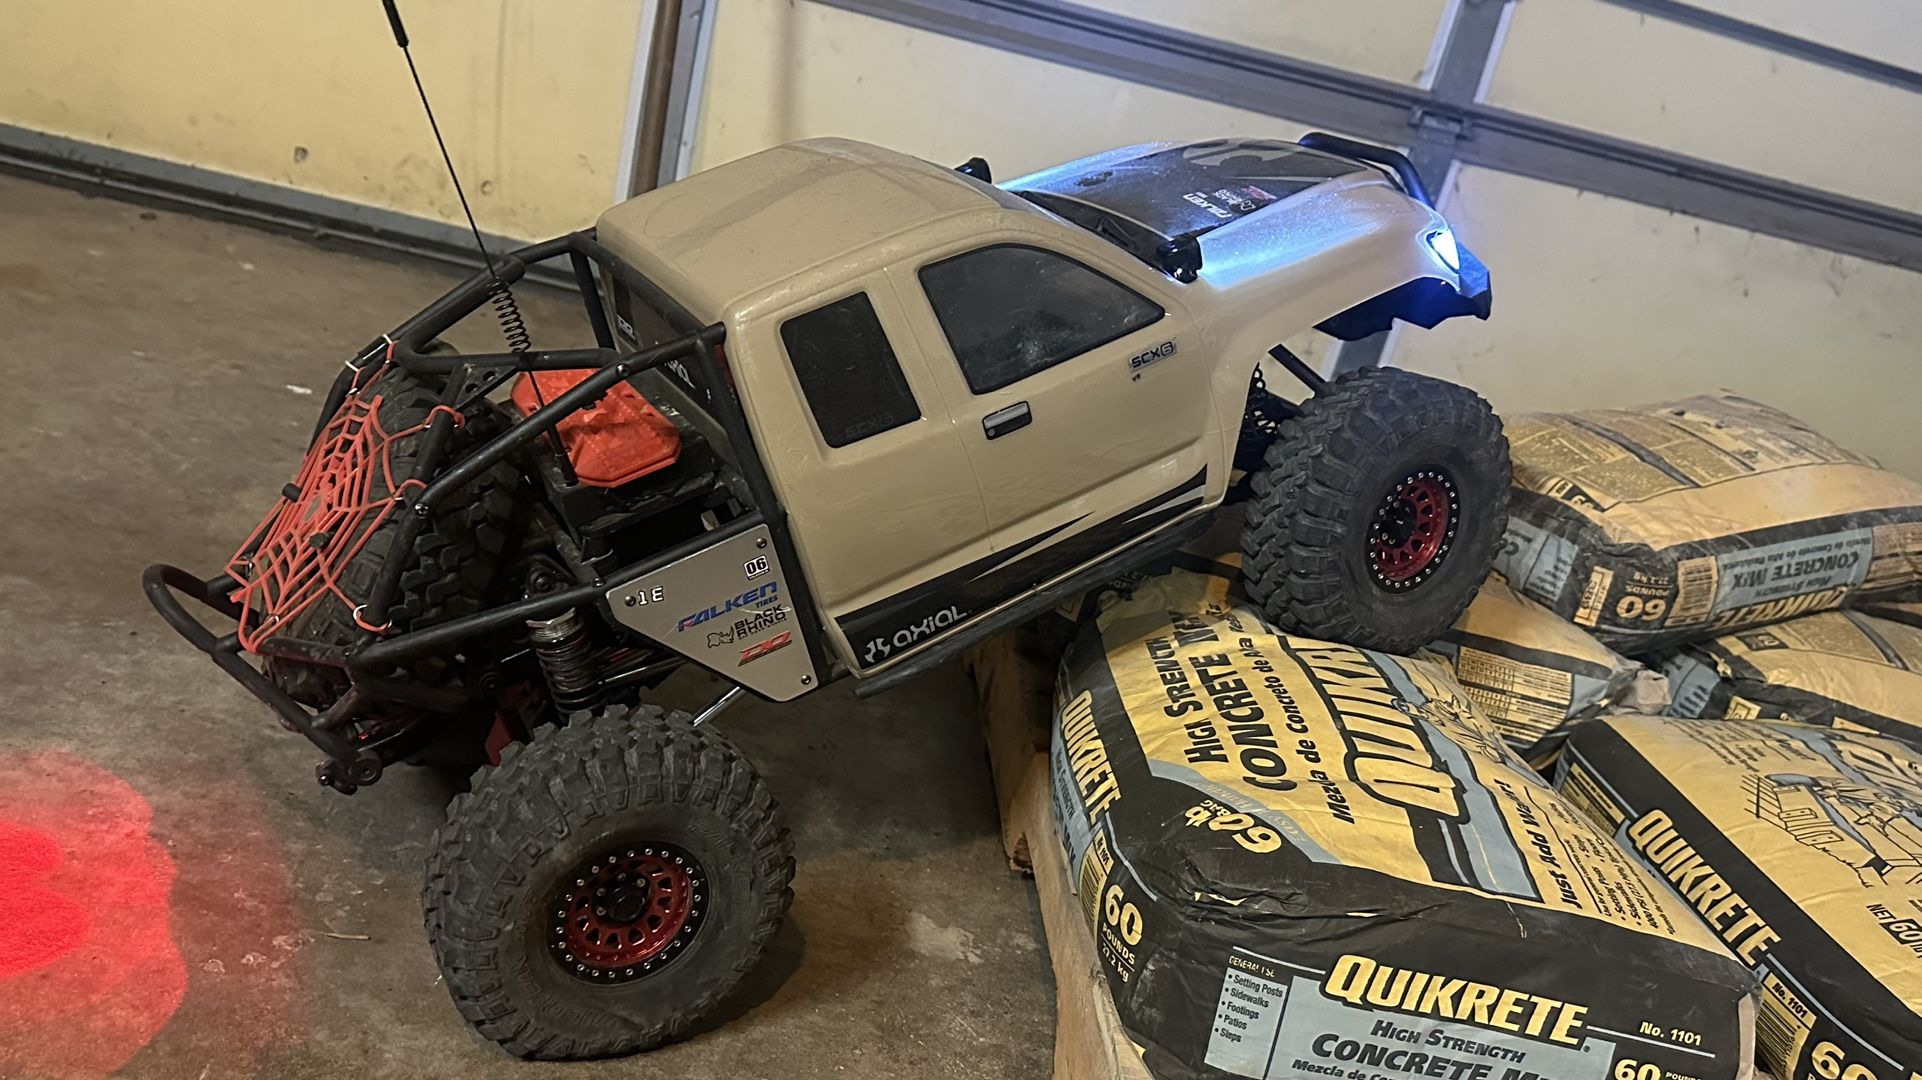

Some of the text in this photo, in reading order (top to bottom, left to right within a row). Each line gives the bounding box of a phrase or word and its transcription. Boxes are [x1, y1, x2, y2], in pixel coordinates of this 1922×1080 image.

[1131, 341, 1174, 369] SCX6
[746, 557, 767, 575] 06
[1771, 551, 1859, 582] CONCRETE
[1626, 585, 1670, 597] POUNDS
[677, 581, 777, 632] FALKEN
[735, 604, 783, 631] BLACK
[1616, 596, 1667, 621] 60
[737, 612, 787, 638] RHINO
[1264, 675, 1311, 734] Concreto
[1188, 651, 1298, 792] CONCRETE
[1062, 690, 1122, 826] QUIKRETE
[1296, 739, 1322, 765] de
[1207, 812, 1282, 854] 60
[1525, 829, 1562, 870] Add
[1548, 869, 1584, 910] Just
[1628, 808, 1783, 966] QUIKRETE
[1105, 884, 1144, 947] 60
[1866, 903, 1897, 921] NET
[1102, 922, 1137, 966] POUNDS
[1889, 922, 1922, 942] 60
[1117, 961, 1130, 984] kg
[1233, 974, 1284, 998] Setting Posts
[1226, 1001, 1260, 1020] Footings
[1230, 987, 1270, 1009] Sidewalks
[1325, 954, 1589, 1046] QUIKRETE
[1772, 982, 1809, 1019] No. 1101
[1219, 1027, 1242, 1043] Steps
[1223, 1014, 1248, 1030] Patios
[1639, 1021, 1702, 1047] No. 1101
[1369, 1019, 1527, 1064] HIGH STRENGTH
[1291, 1059, 1345, 1079] Mezcla
[1311, 1033, 1494, 1080] CONCRETE
